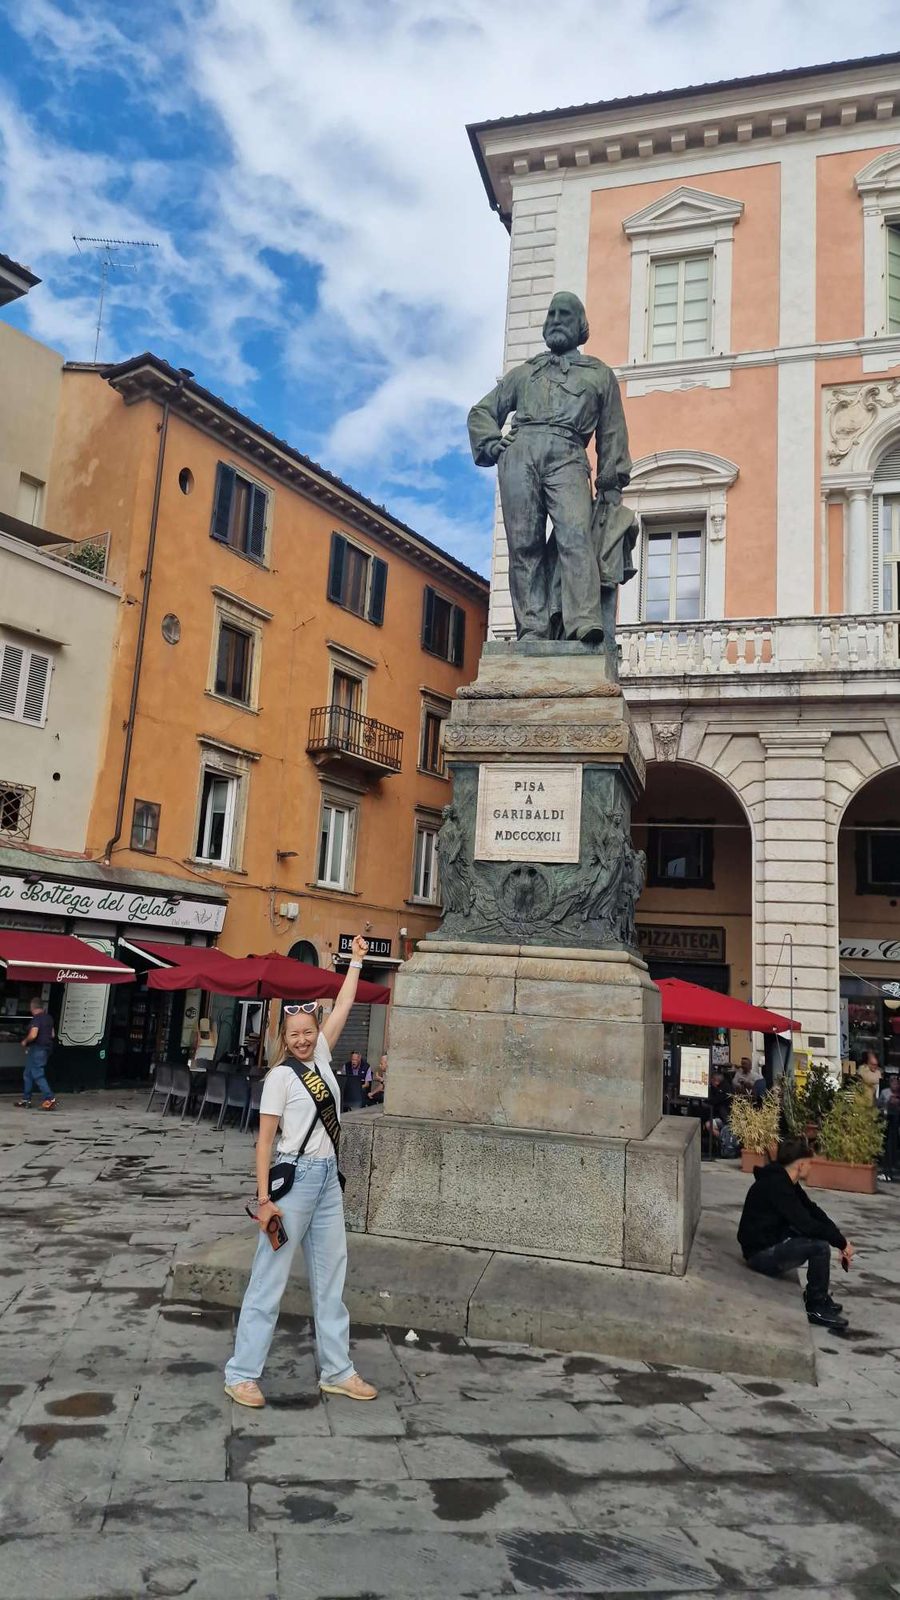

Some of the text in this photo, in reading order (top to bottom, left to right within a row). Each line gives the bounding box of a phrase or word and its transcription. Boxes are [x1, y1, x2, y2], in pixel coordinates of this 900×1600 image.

[514, 781, 545, 792] PISA
[525, 794, 533, 805] A
[493, 809, 565, 820] GARIBALDI
[494, 830, 561, 842] MDCCCXCII
[0, 881, 180, 921] a Bottega del Gelato
[638, 929, 720, 949] PIZZATECA
[838, 939, 877, 958] ar
[57, 969, 89, 982] Gelateria
[301, 1070, 329, 1102] MISS
